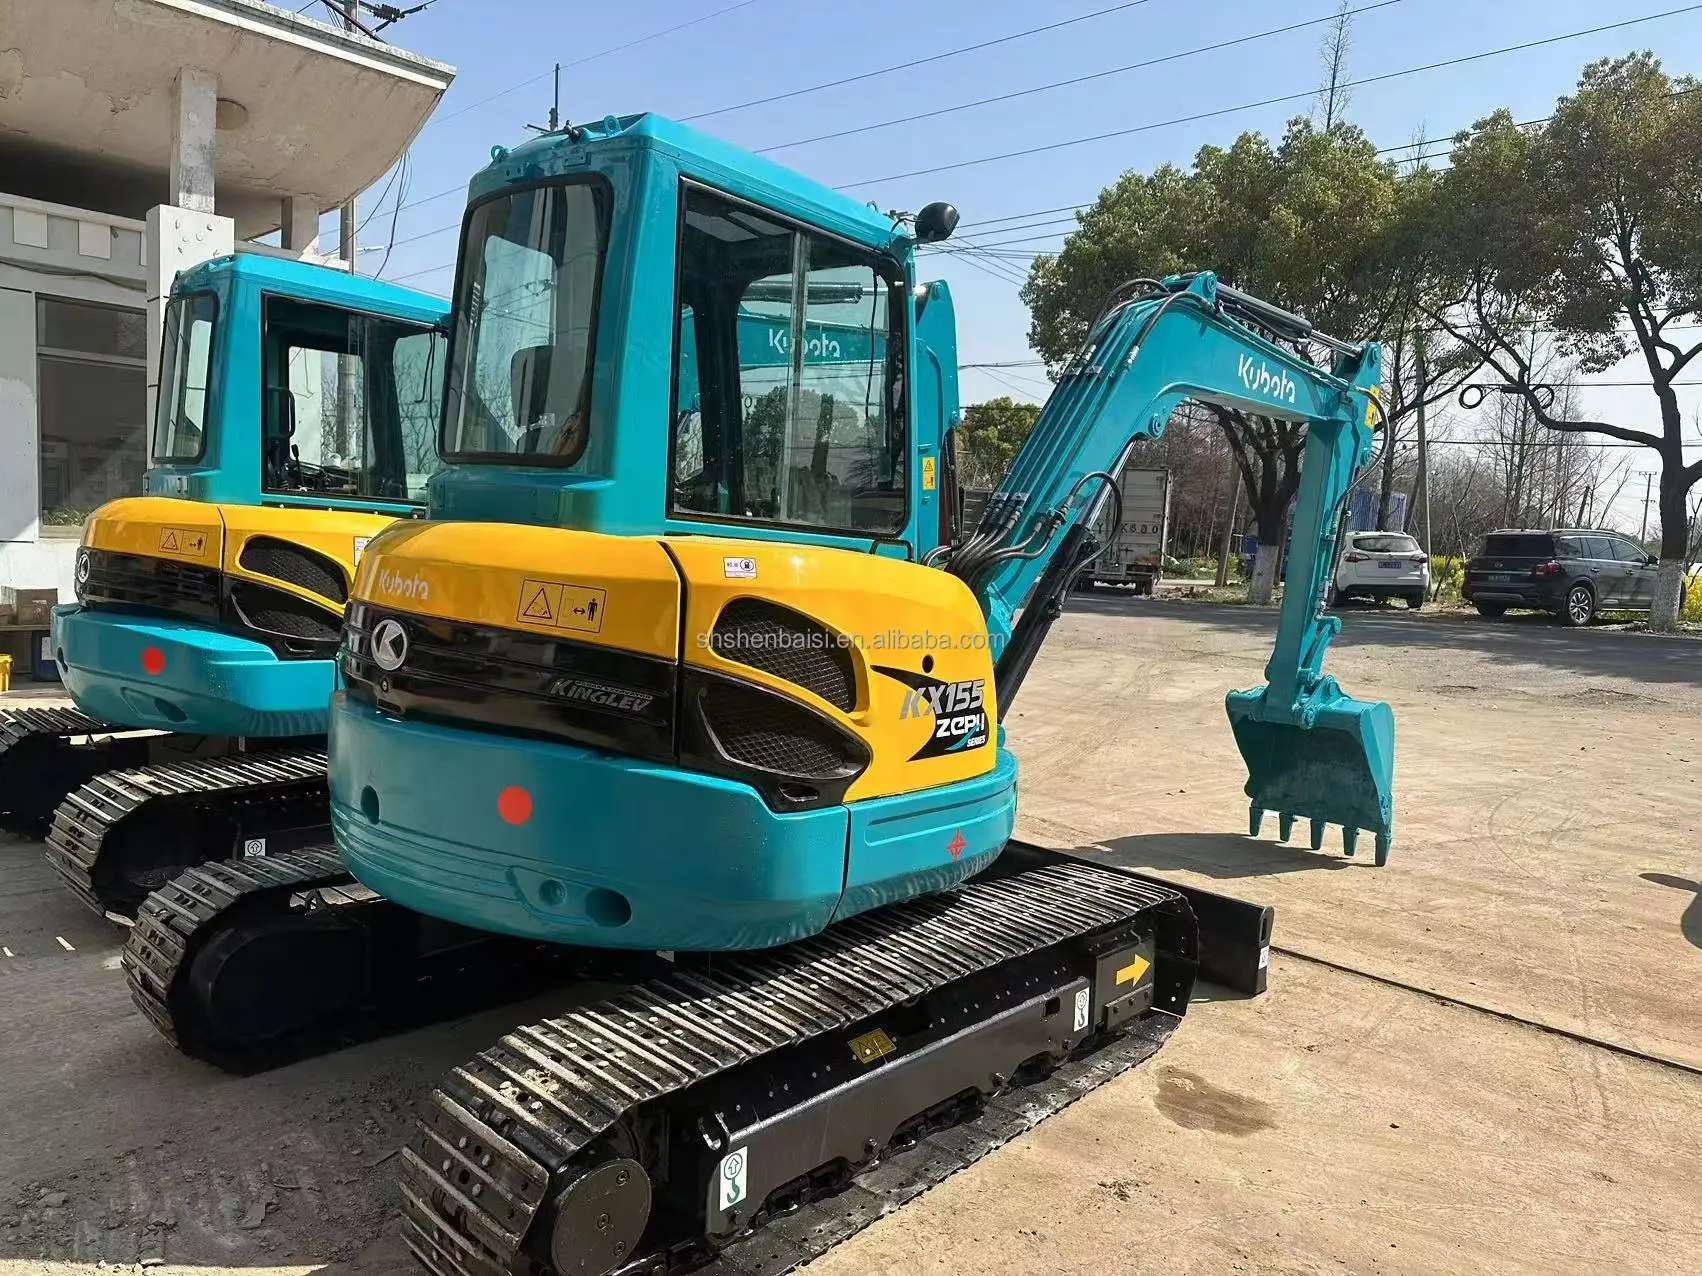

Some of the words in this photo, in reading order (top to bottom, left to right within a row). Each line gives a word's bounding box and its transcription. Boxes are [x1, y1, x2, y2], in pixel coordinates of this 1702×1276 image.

[1238, 353, 1296, 403] Kubota
[379, 567, 429, 600] Kubota
[549, 679, 652, 711] KINGLEV
[899, 679, 985, 720] KX155
[966, 735, 986, 748] SERIES
